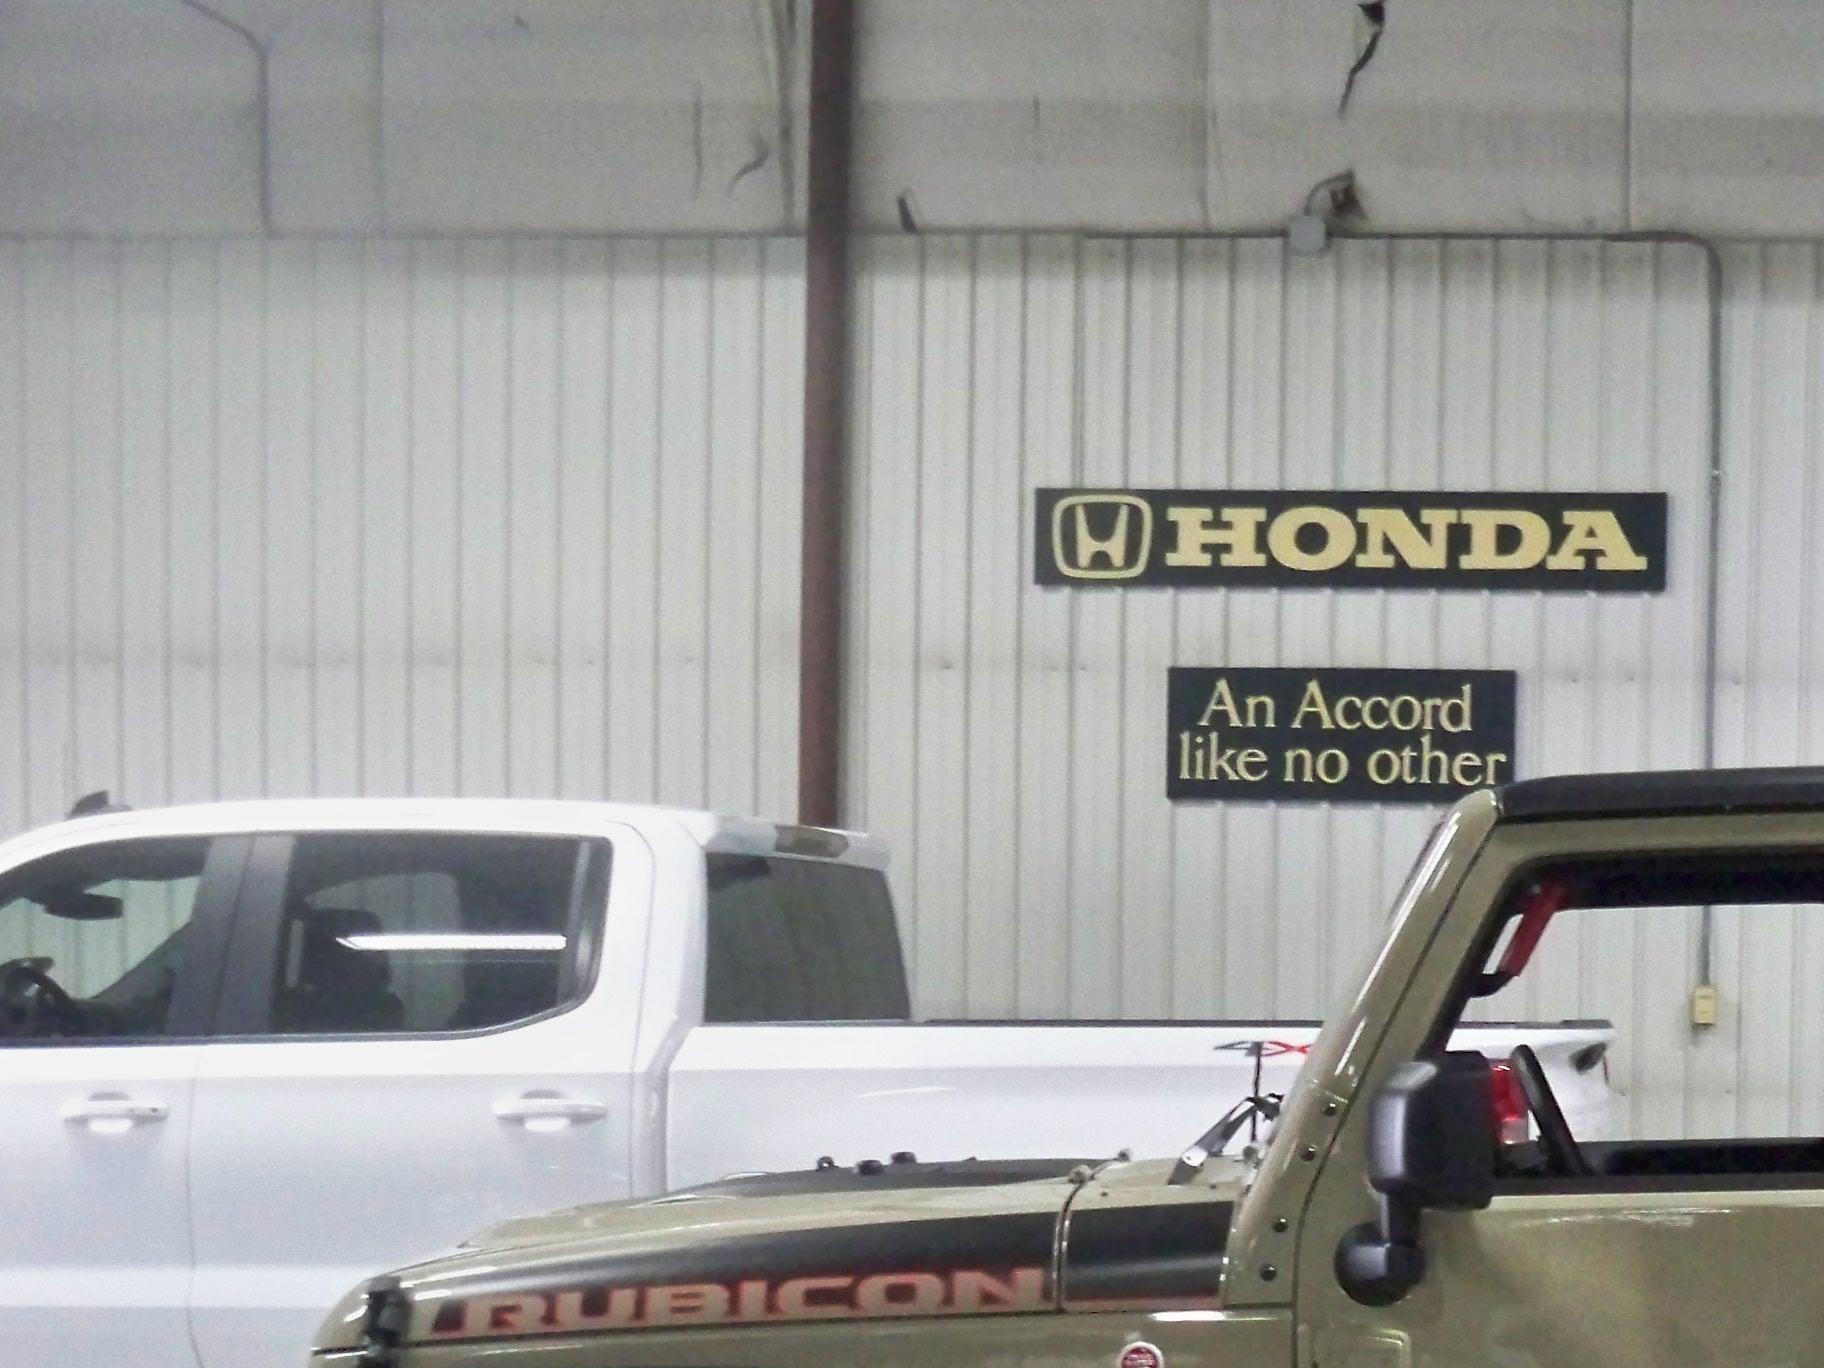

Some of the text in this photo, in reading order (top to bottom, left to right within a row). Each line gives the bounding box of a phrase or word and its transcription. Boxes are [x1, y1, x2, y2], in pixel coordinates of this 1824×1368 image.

[1164, 506, 1648, 571] HONDA
[1197, 678, 1474, 733] An Accord
[1178, 732, 1508, 788] like no other
[431, 1267, 1047, 1338] RUBICON
